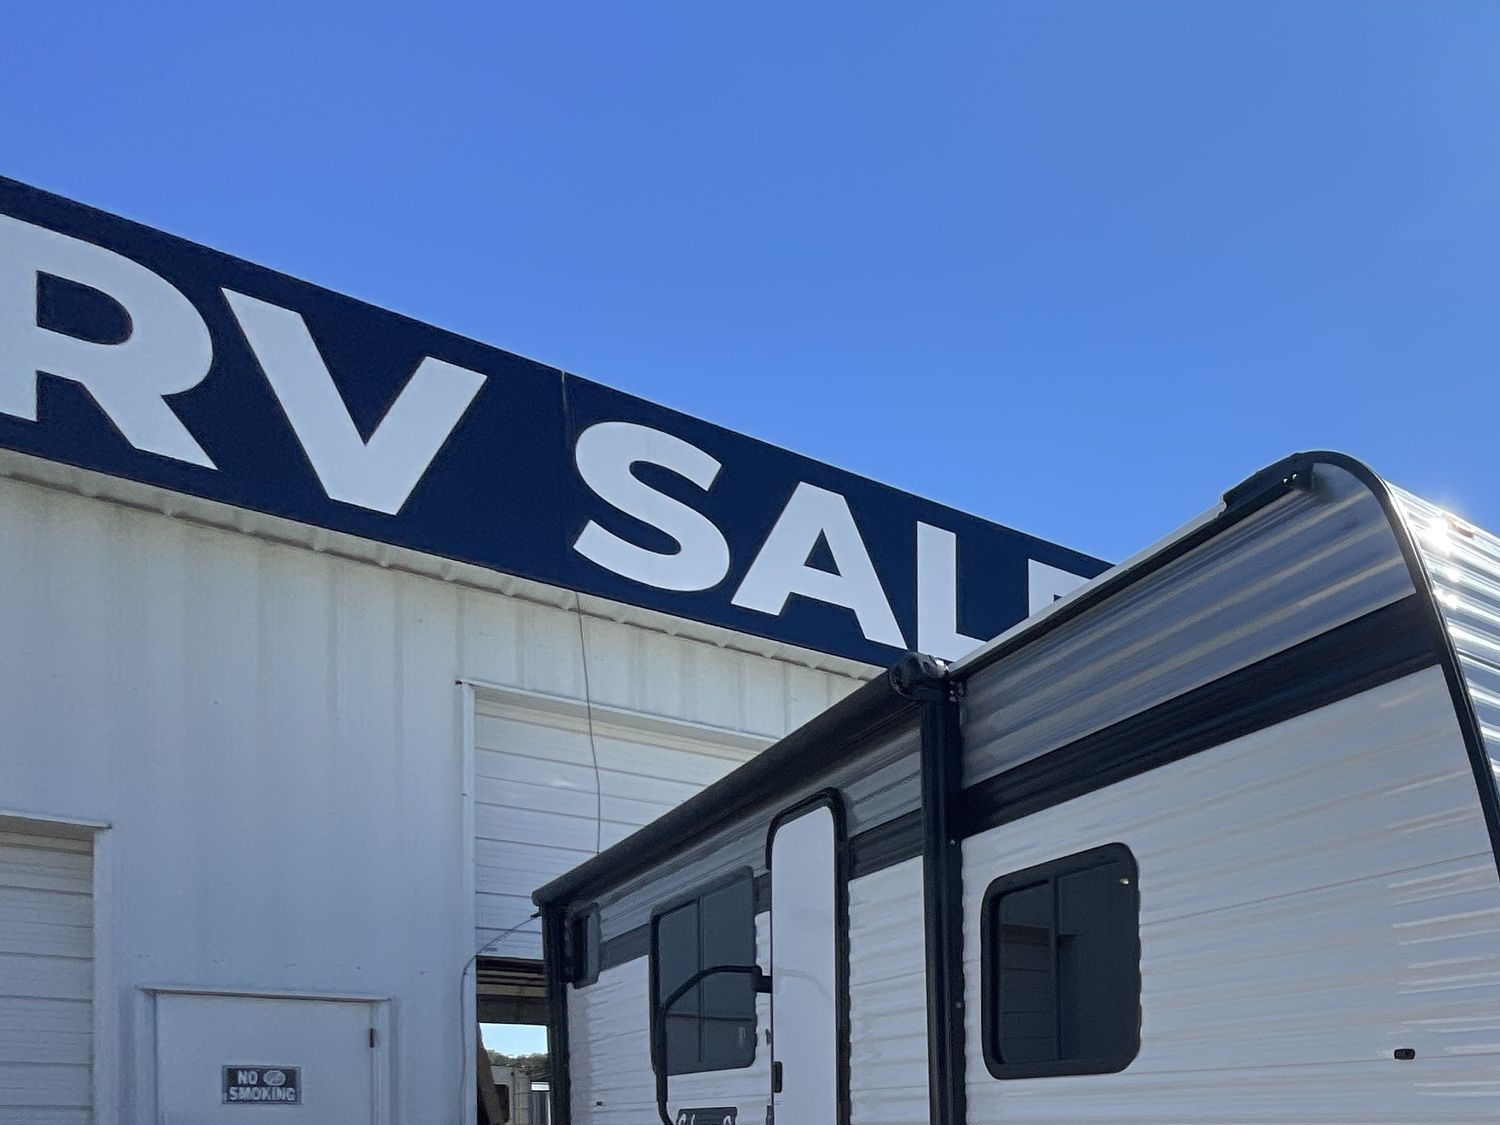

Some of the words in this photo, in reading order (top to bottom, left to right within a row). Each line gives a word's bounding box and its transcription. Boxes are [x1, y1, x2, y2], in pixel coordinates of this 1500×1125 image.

[0, 214, 488, 515] RV
[237, 1070, 259, 1085] NO
[229, 1086, 297, 1101] SMOKING
